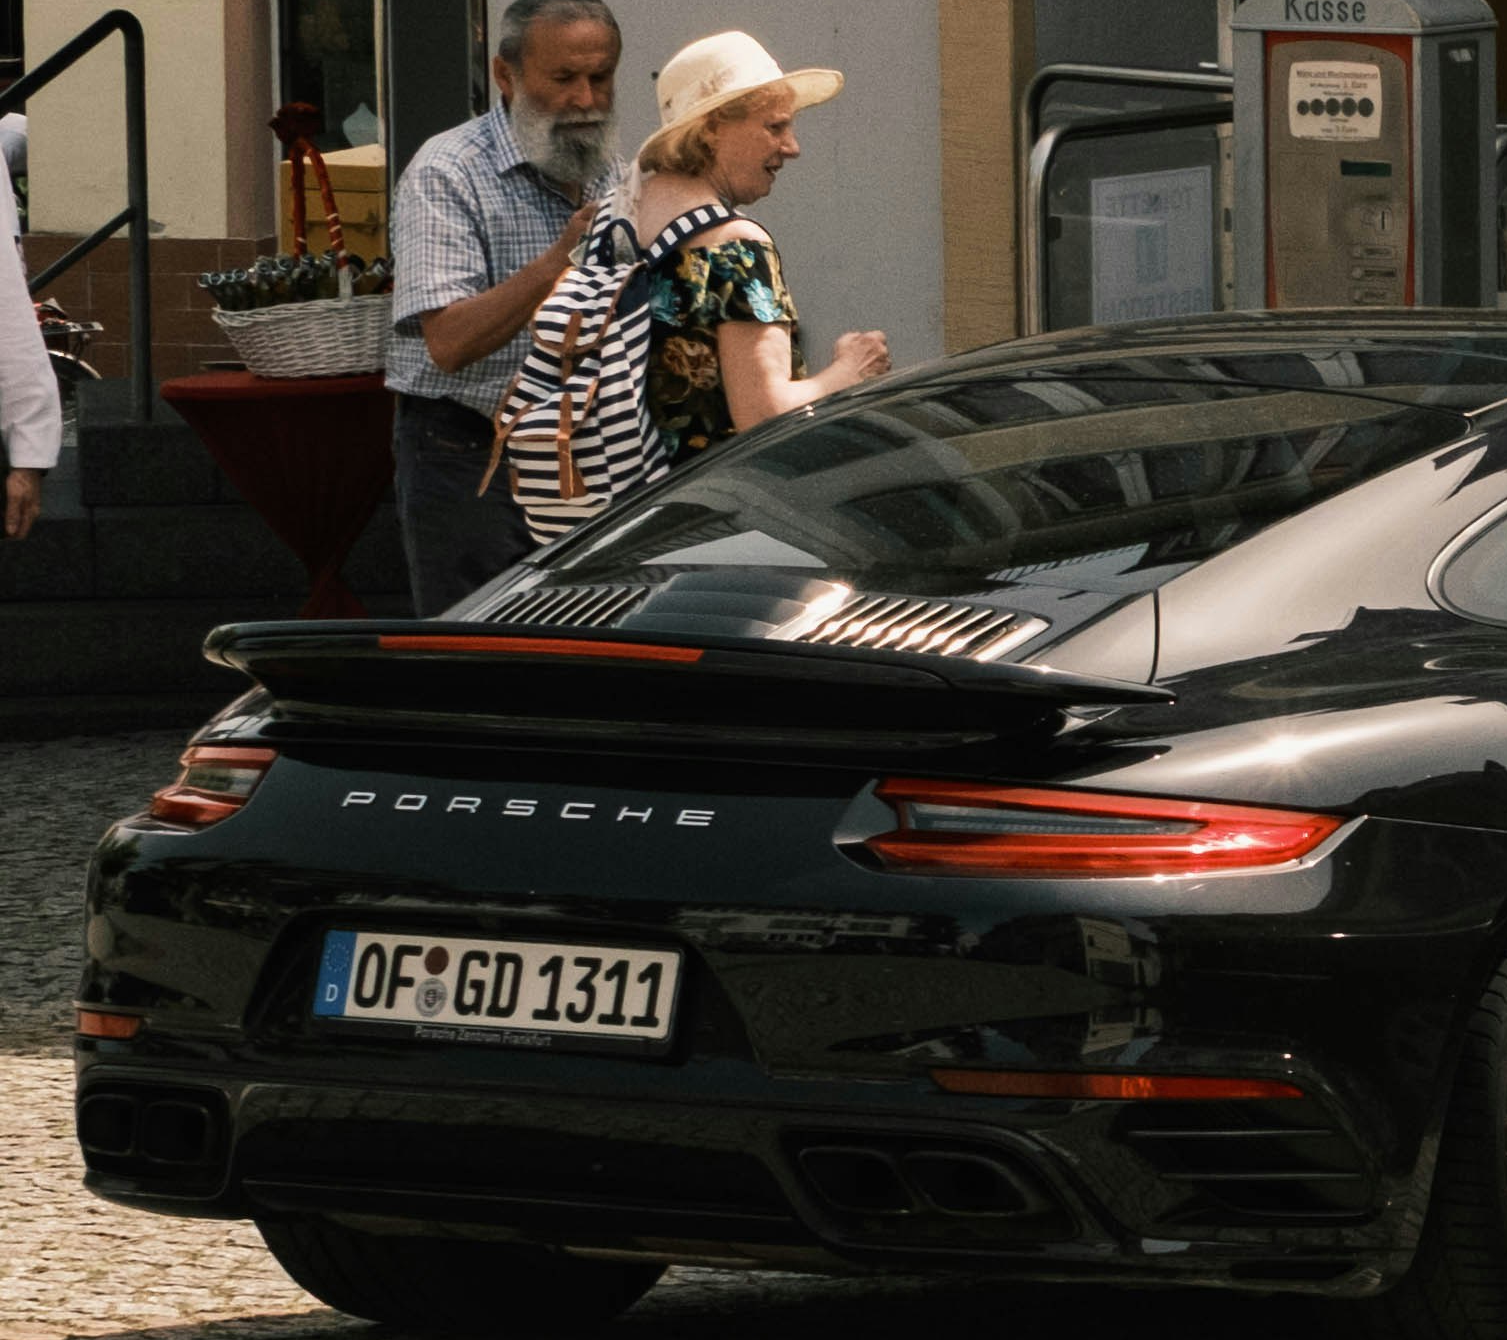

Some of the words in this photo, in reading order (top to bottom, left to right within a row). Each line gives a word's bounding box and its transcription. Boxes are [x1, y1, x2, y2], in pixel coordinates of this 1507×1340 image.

[341, 791, 715, 826] PORSCHE
[326, 984, 339, 1003] D
[354, 942, 424, 1009] OF
[454, 950, 523, 1018] GD
[532, 955, 663, 1028] 1311
